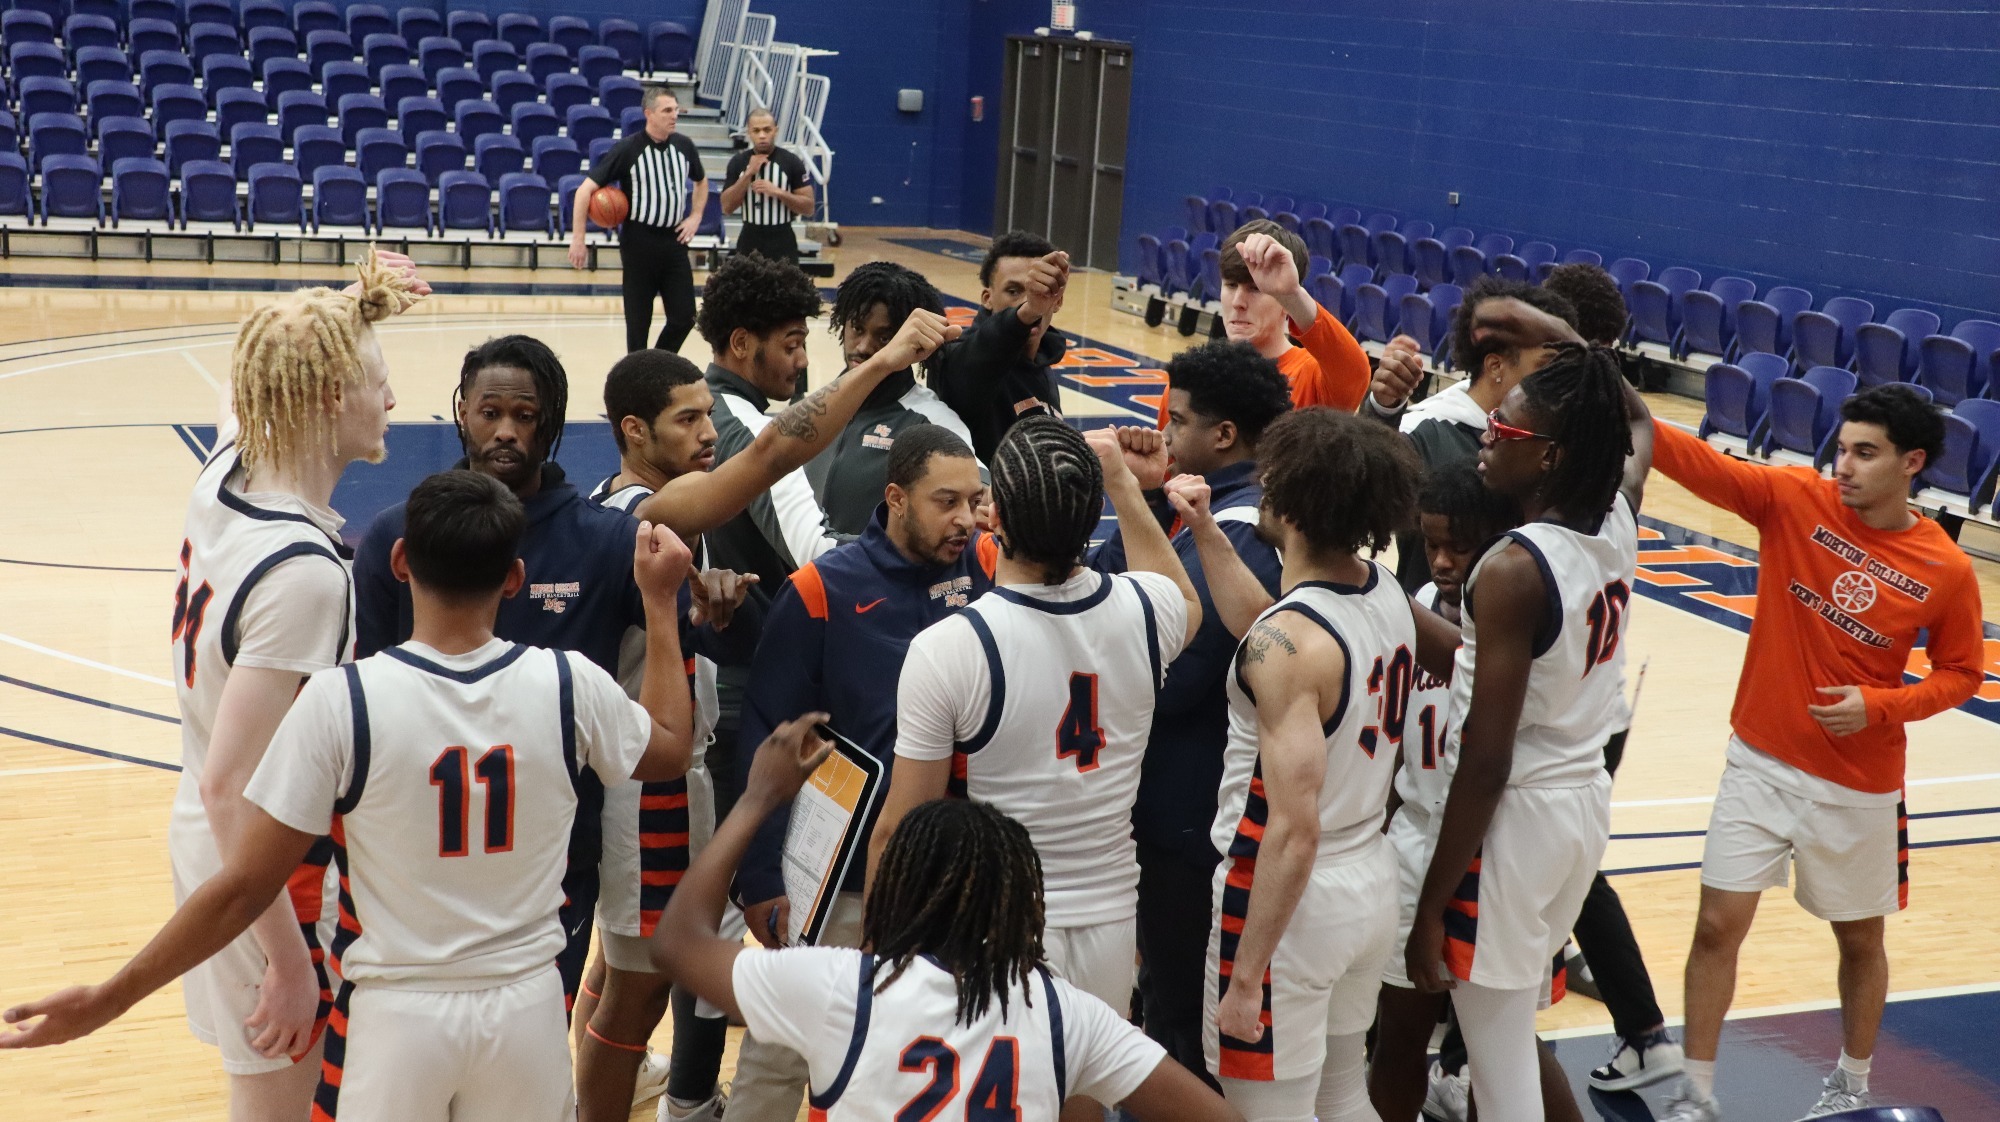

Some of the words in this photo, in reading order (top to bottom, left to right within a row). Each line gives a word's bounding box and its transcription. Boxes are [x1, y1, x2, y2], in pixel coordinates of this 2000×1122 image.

[1810, 525, 1867, 568] MORTON
[1788, 579, 1822, 610] MEN'S
[1818, 601, 1894, 649] BASKETBALL
[1055, 670, 1107, 773] 4
[429, 744, 516, 858] 11
[893, 1035, 1023, 1122] 24
